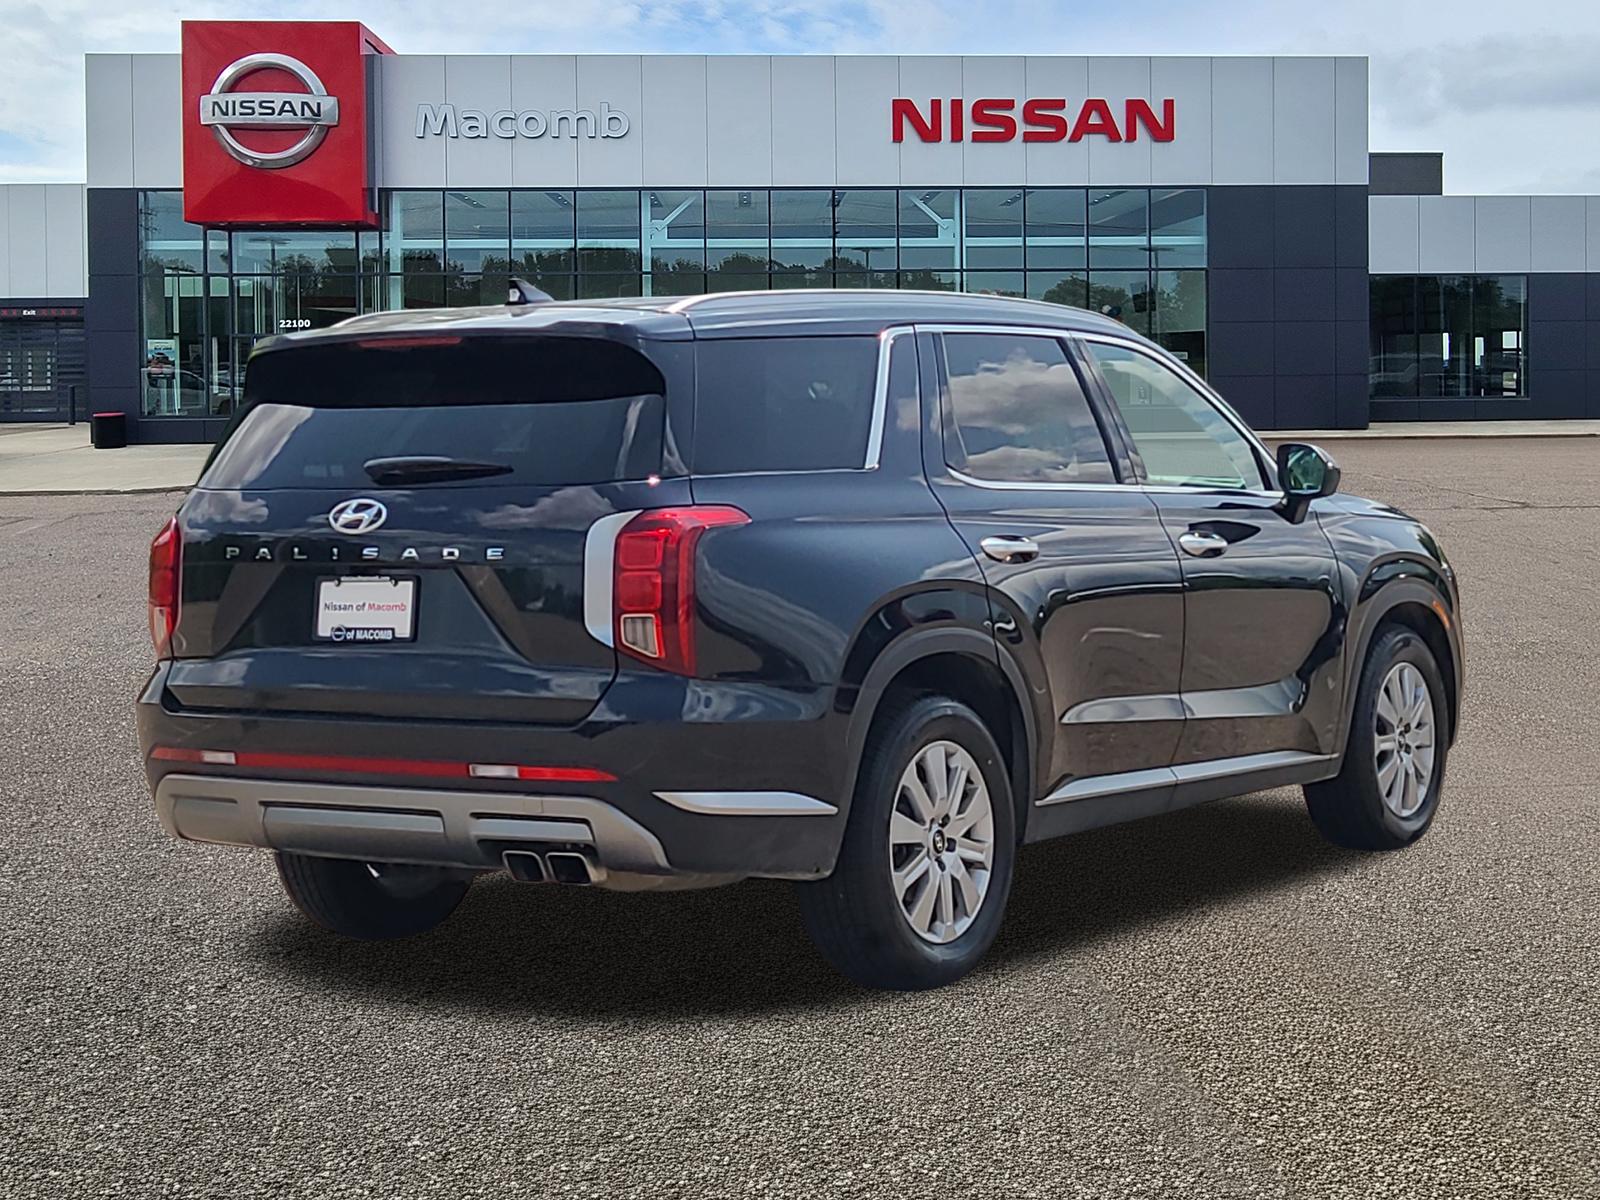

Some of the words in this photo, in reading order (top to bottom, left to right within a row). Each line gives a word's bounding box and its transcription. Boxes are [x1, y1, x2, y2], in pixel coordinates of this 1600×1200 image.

[212, 100, 322, 117] NISSAN
[415, 102, 630, 139] Macomb
[892, 98, 1175, 142] NISSAN
[279, 319, 311, 328] 22100
[225, 547, 505, 560] PALISADE
[324, 602, 354, 611] Nissan
[355, 602, 366, 611] of
[367, 602, 407, 611] Macomb
[346, 630, 355, 639] of
[355, 629, 393, 640] MACOMB
